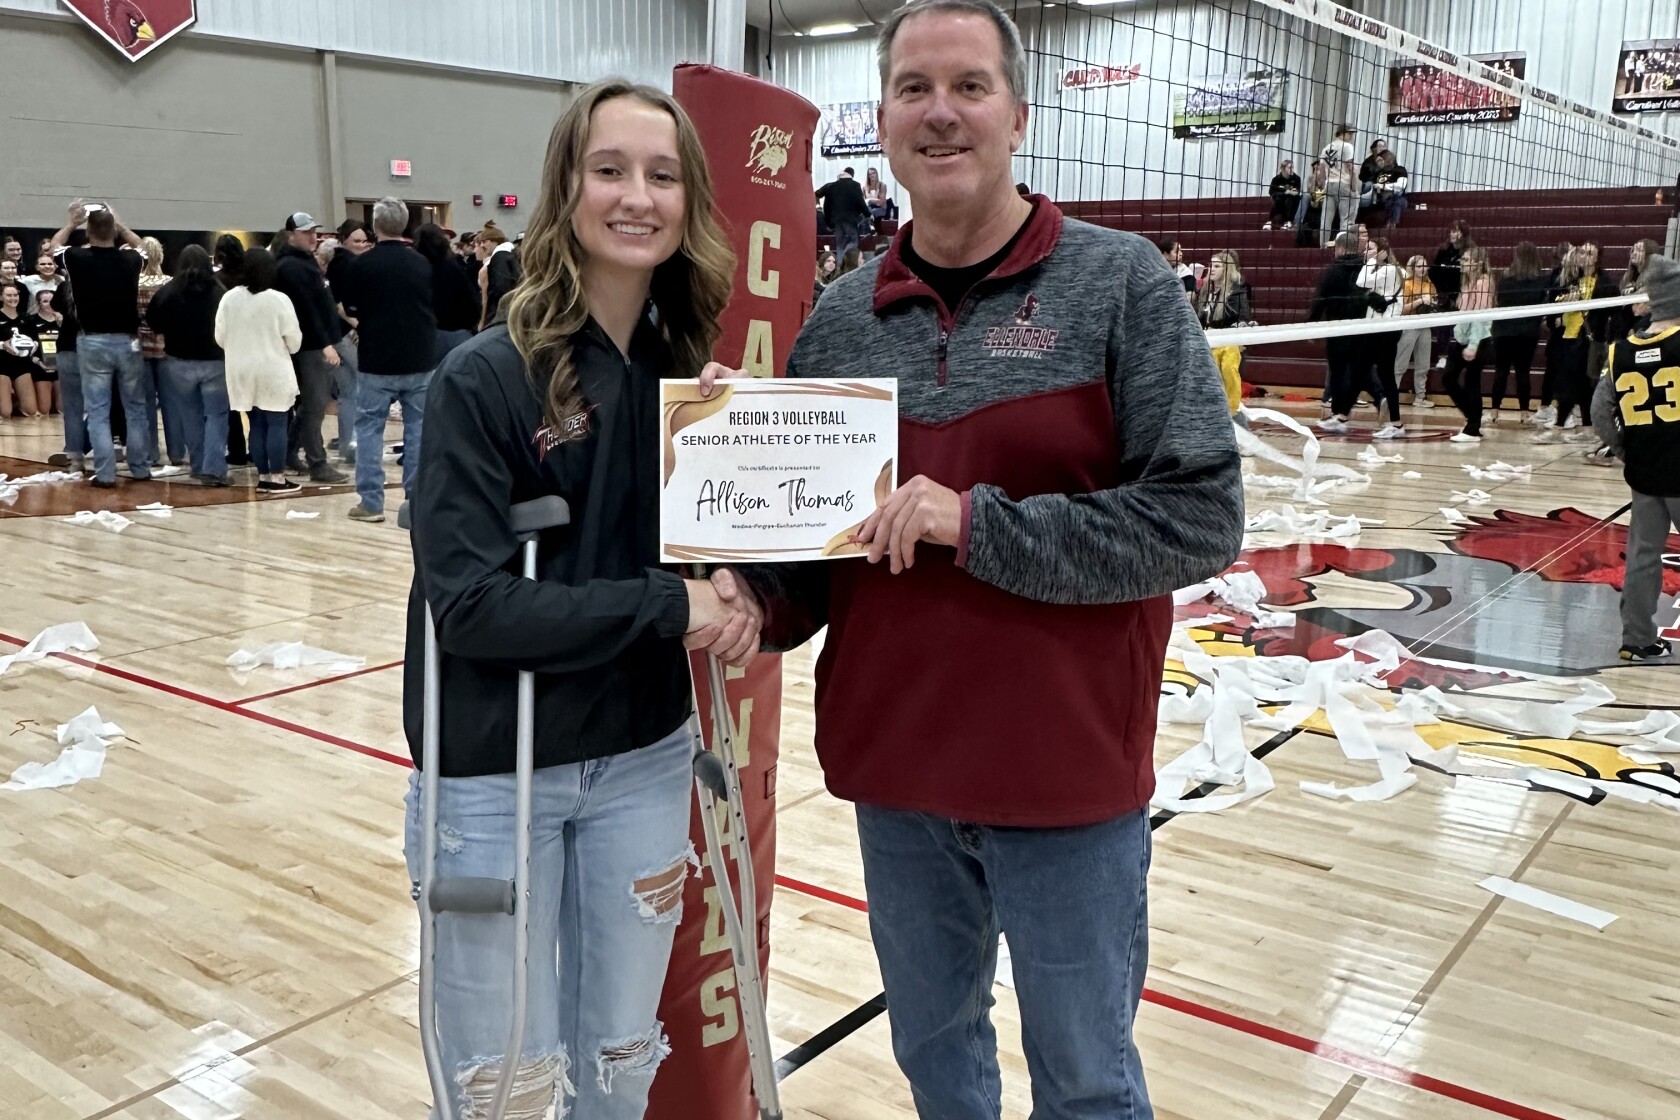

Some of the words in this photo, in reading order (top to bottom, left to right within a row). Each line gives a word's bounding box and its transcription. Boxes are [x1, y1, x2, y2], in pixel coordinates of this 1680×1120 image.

[745, 125, 794, 168] Bison
[982, 326, 1059, 351] ELLENDALE
[990, 348, 1043, 359] BASKETBALL
[1615, 366, 1680, 426] 23
[729, 411, 769, 426] REGION
[772, 411, 780, 425] 3
[782, 410, 847, 425] VOLLEYBALL
[681, 435, 730, 446] SENIOR
[733, 434, 791, 446] ATHLETE
[794, 434, 811, 445] OF
[814, 434, 840, 445] THE
[842, 433, 877, 444] YEAR
[696, 479, 770, 522] Allison
[778, 477, 855, 516] Thomas
